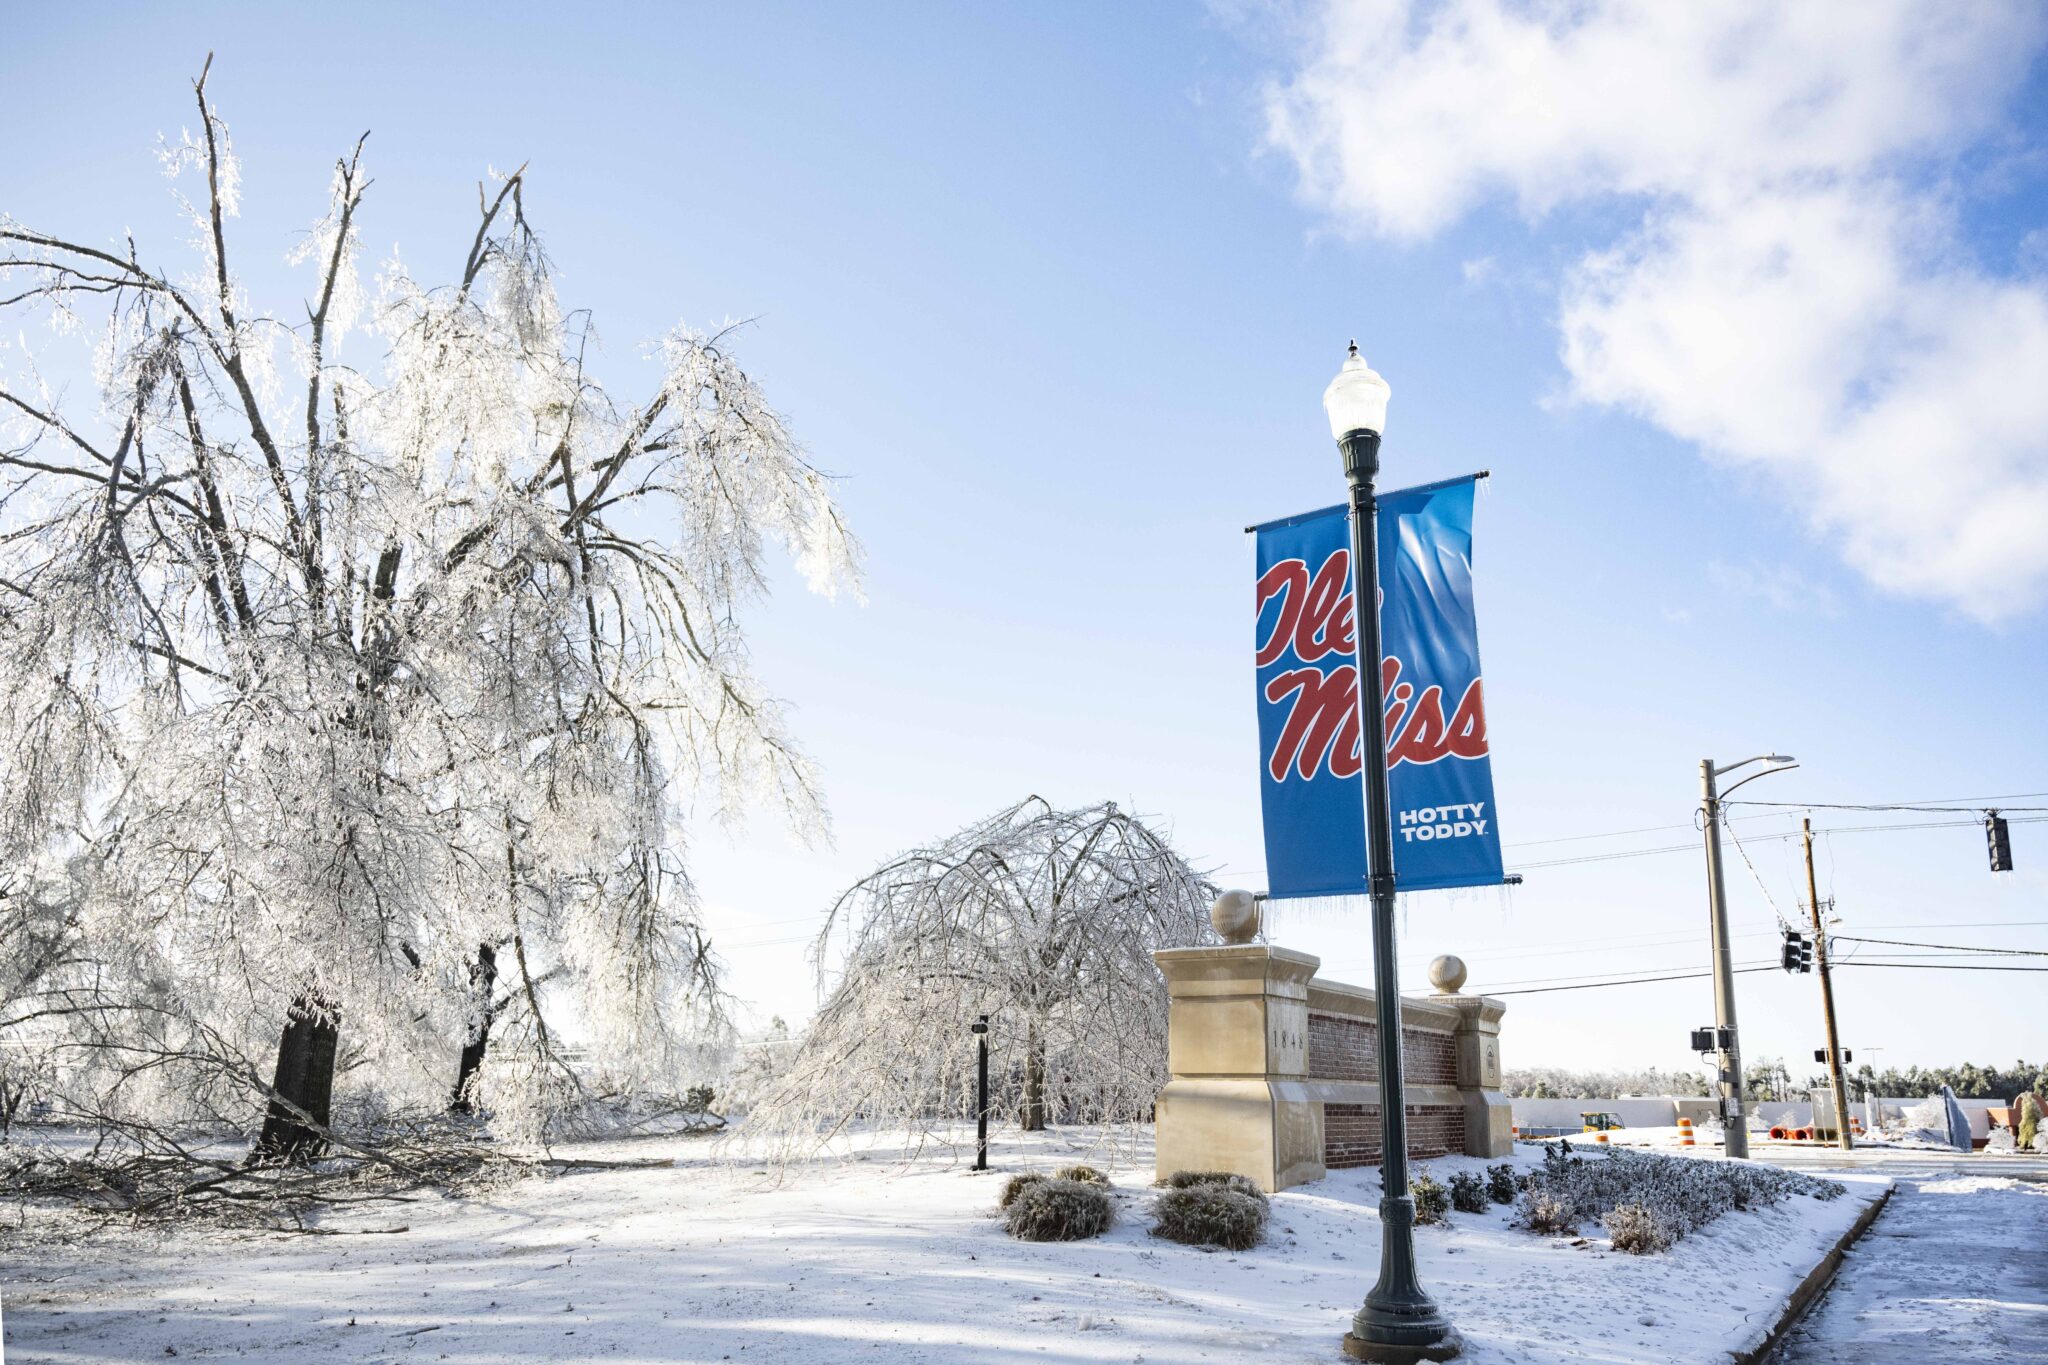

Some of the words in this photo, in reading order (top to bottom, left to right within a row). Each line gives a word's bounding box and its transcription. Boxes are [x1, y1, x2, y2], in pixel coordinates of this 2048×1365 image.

[1256, 548, 1384, 668] Ole
[1265, 656, 1489, 783] Miss
[1400, 802, 1485, 826] HOTTY
[1400, 820, 1487, 842] TODDY
[1273, 1030, 1304, 1050] 1848
